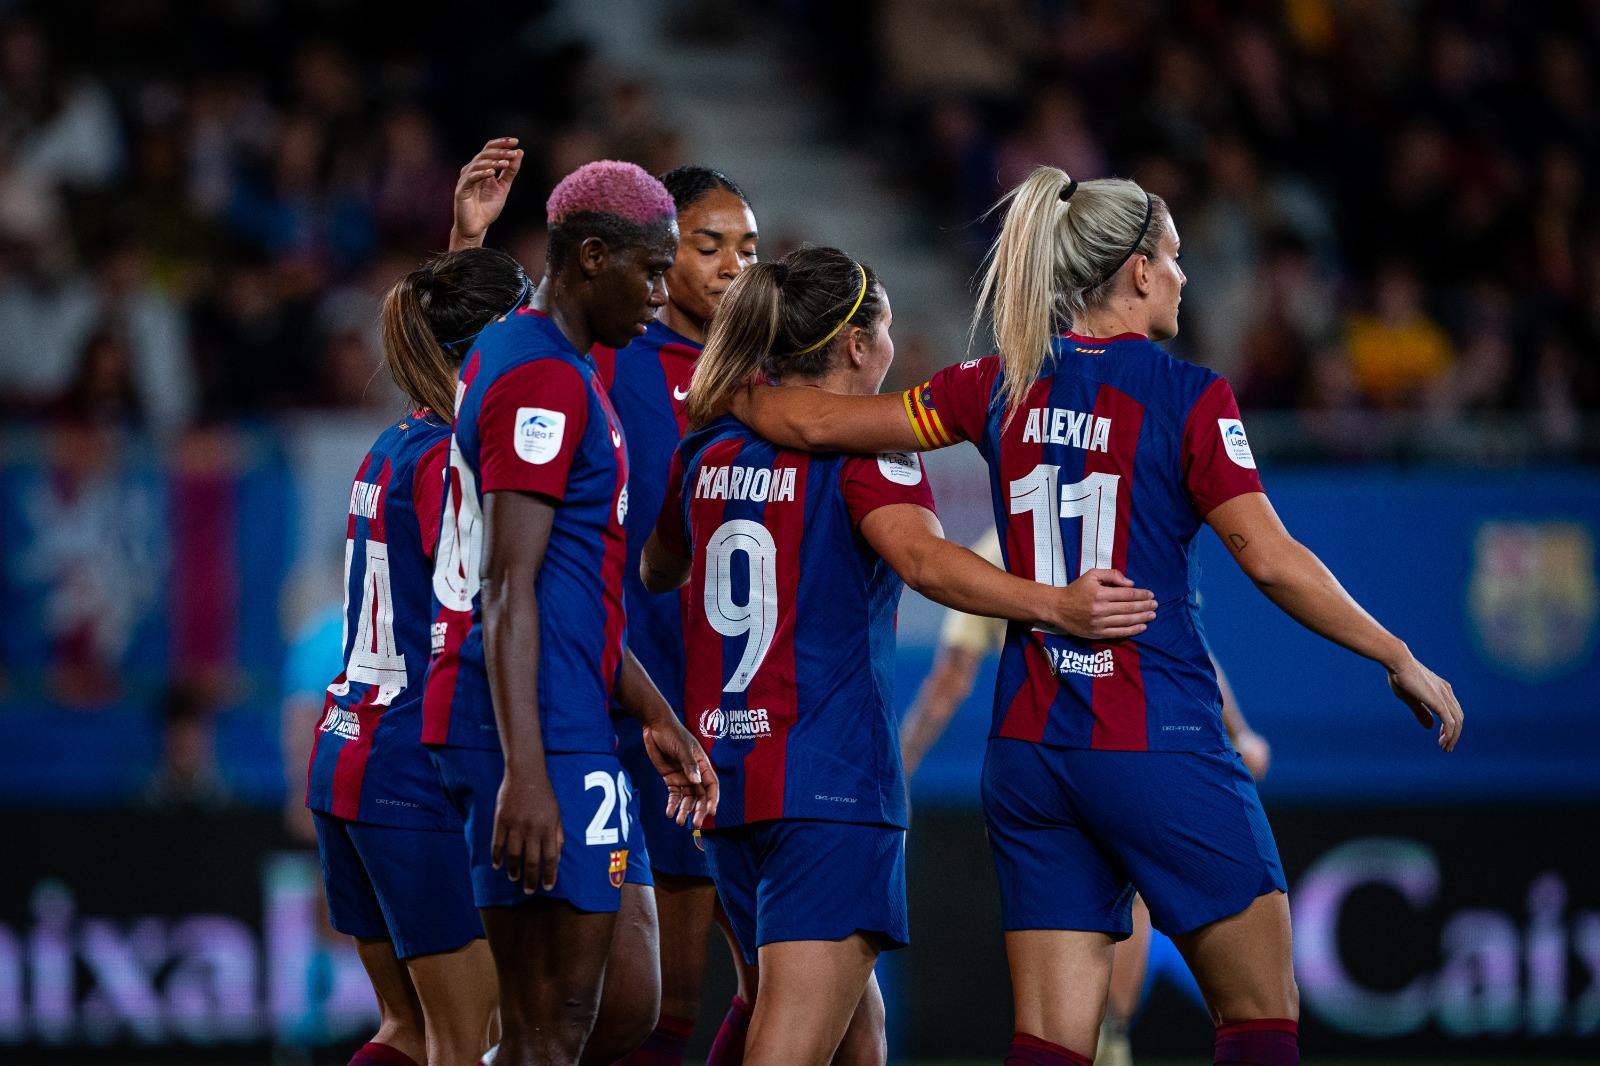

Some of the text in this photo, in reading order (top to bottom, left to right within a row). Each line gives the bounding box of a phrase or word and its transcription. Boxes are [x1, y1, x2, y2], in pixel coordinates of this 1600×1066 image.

[526, 428, 555, 440] Liga F
[1022, 408, 1112, 453] ALEXIA
[889, 457, 909, 467] Liga
[695, 465, 798, 502] MARIONA
[1010, 463, 1121, 634] 11
[703, 518, 778, 693] 9
[1062, 649, 1113, 664] UNHCR
[1060, 658, 1114, 674] ACNUR
[729, 708, 768, 722] UNHCR
[729, 720, 771, 735] ACNUR
